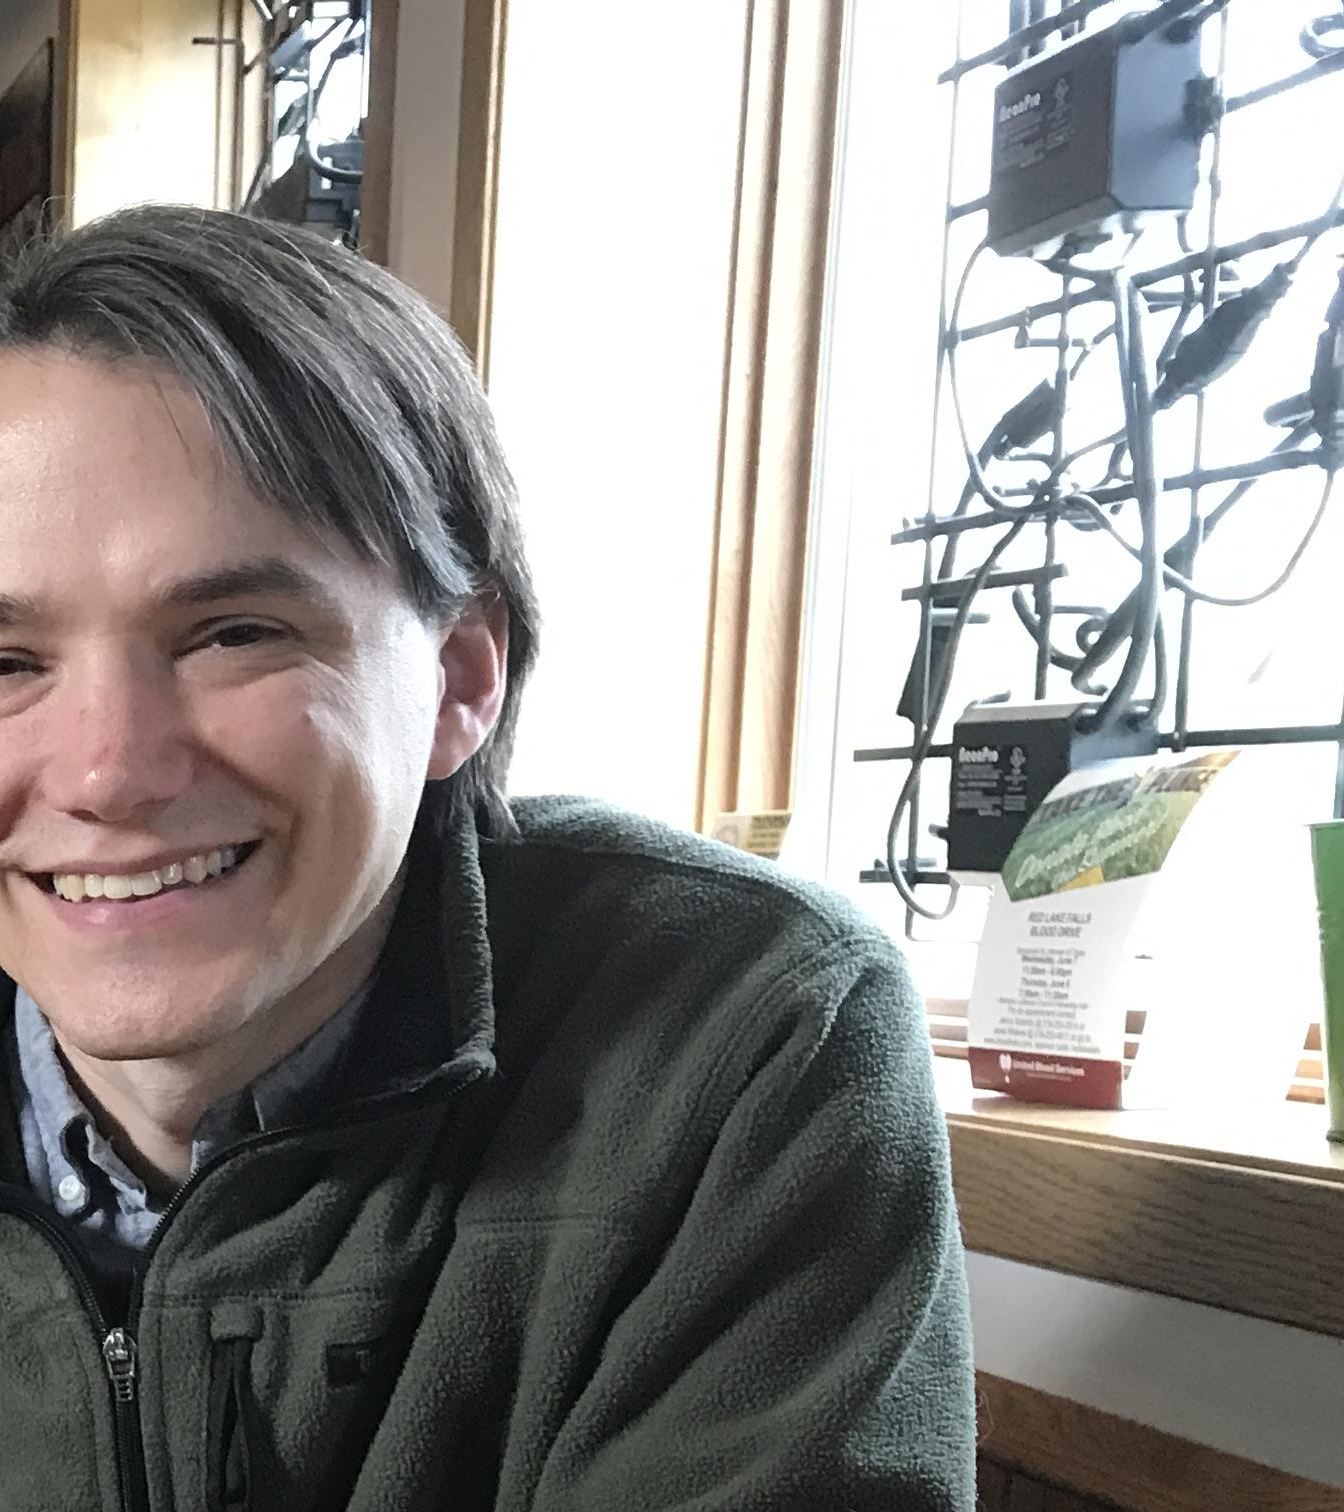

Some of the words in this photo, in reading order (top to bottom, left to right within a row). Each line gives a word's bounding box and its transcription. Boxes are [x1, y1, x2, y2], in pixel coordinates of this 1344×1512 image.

[1027, 911, 1044, 924] RED
[1045, 911, 1066, 924] LAKE
[1066, 911, 1092, 925] FALLS
[1029, 926, 1058, 937] BLOOD
[1058, 926, 1082, 938] DRIVE
